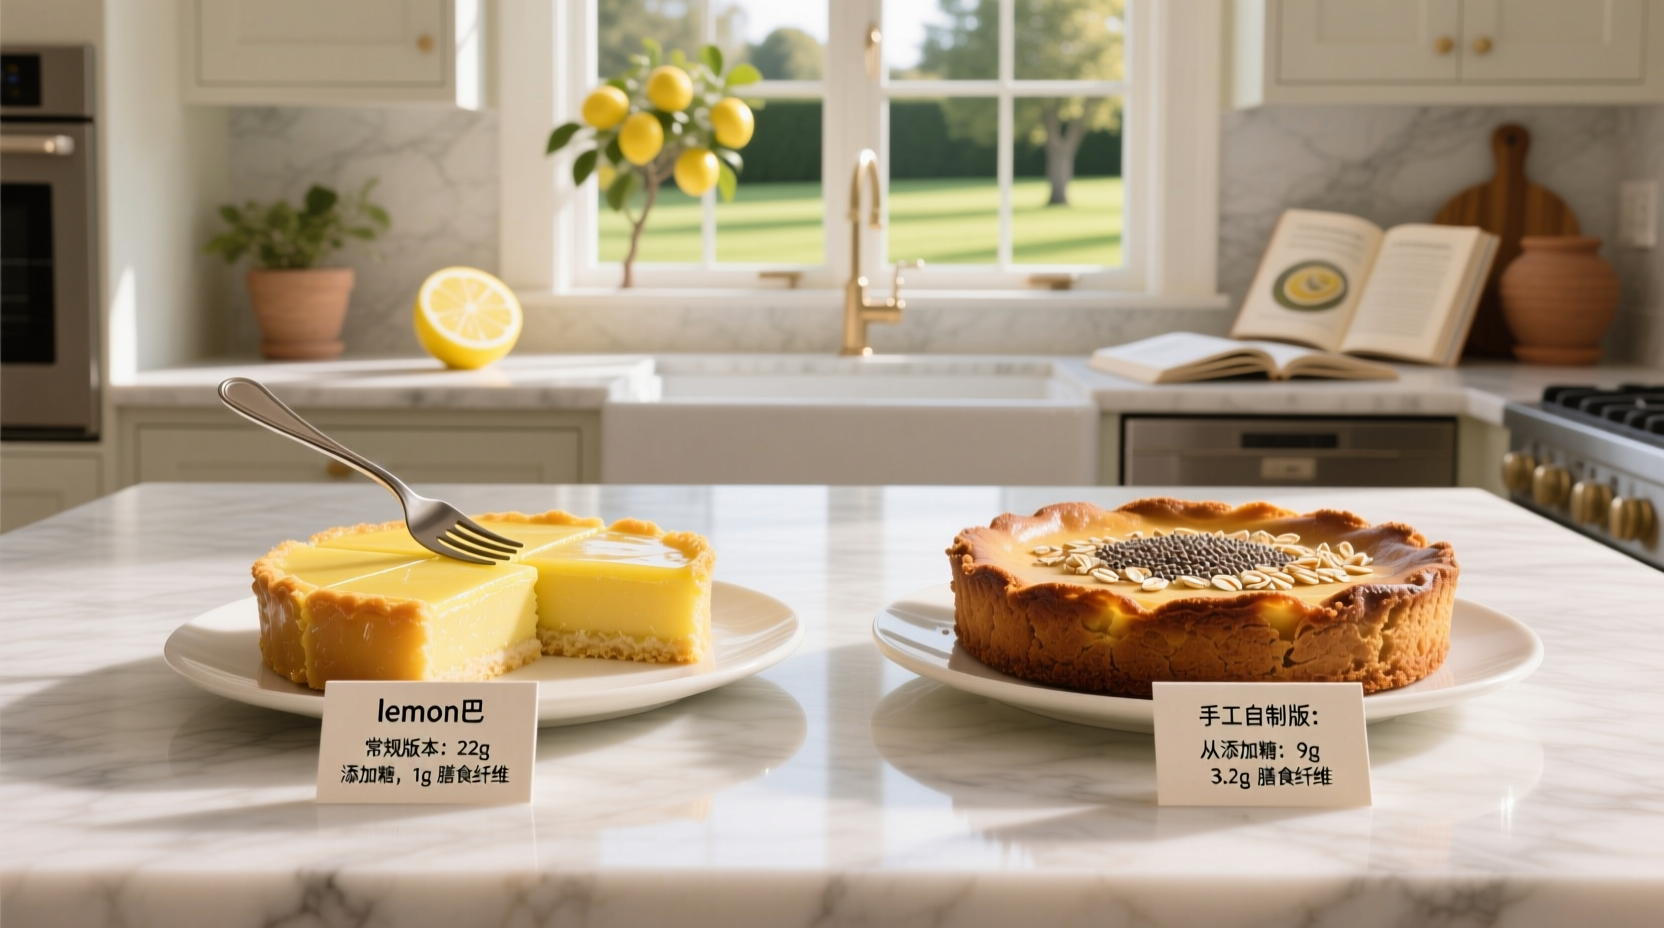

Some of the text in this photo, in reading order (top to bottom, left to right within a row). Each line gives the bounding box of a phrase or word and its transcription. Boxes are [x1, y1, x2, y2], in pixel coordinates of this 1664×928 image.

[377, 697, 485, 724] lemon巴
[436, 763, 510, 785] 膳食纤维
[1210, 767, 1252, 790] 3.2g
